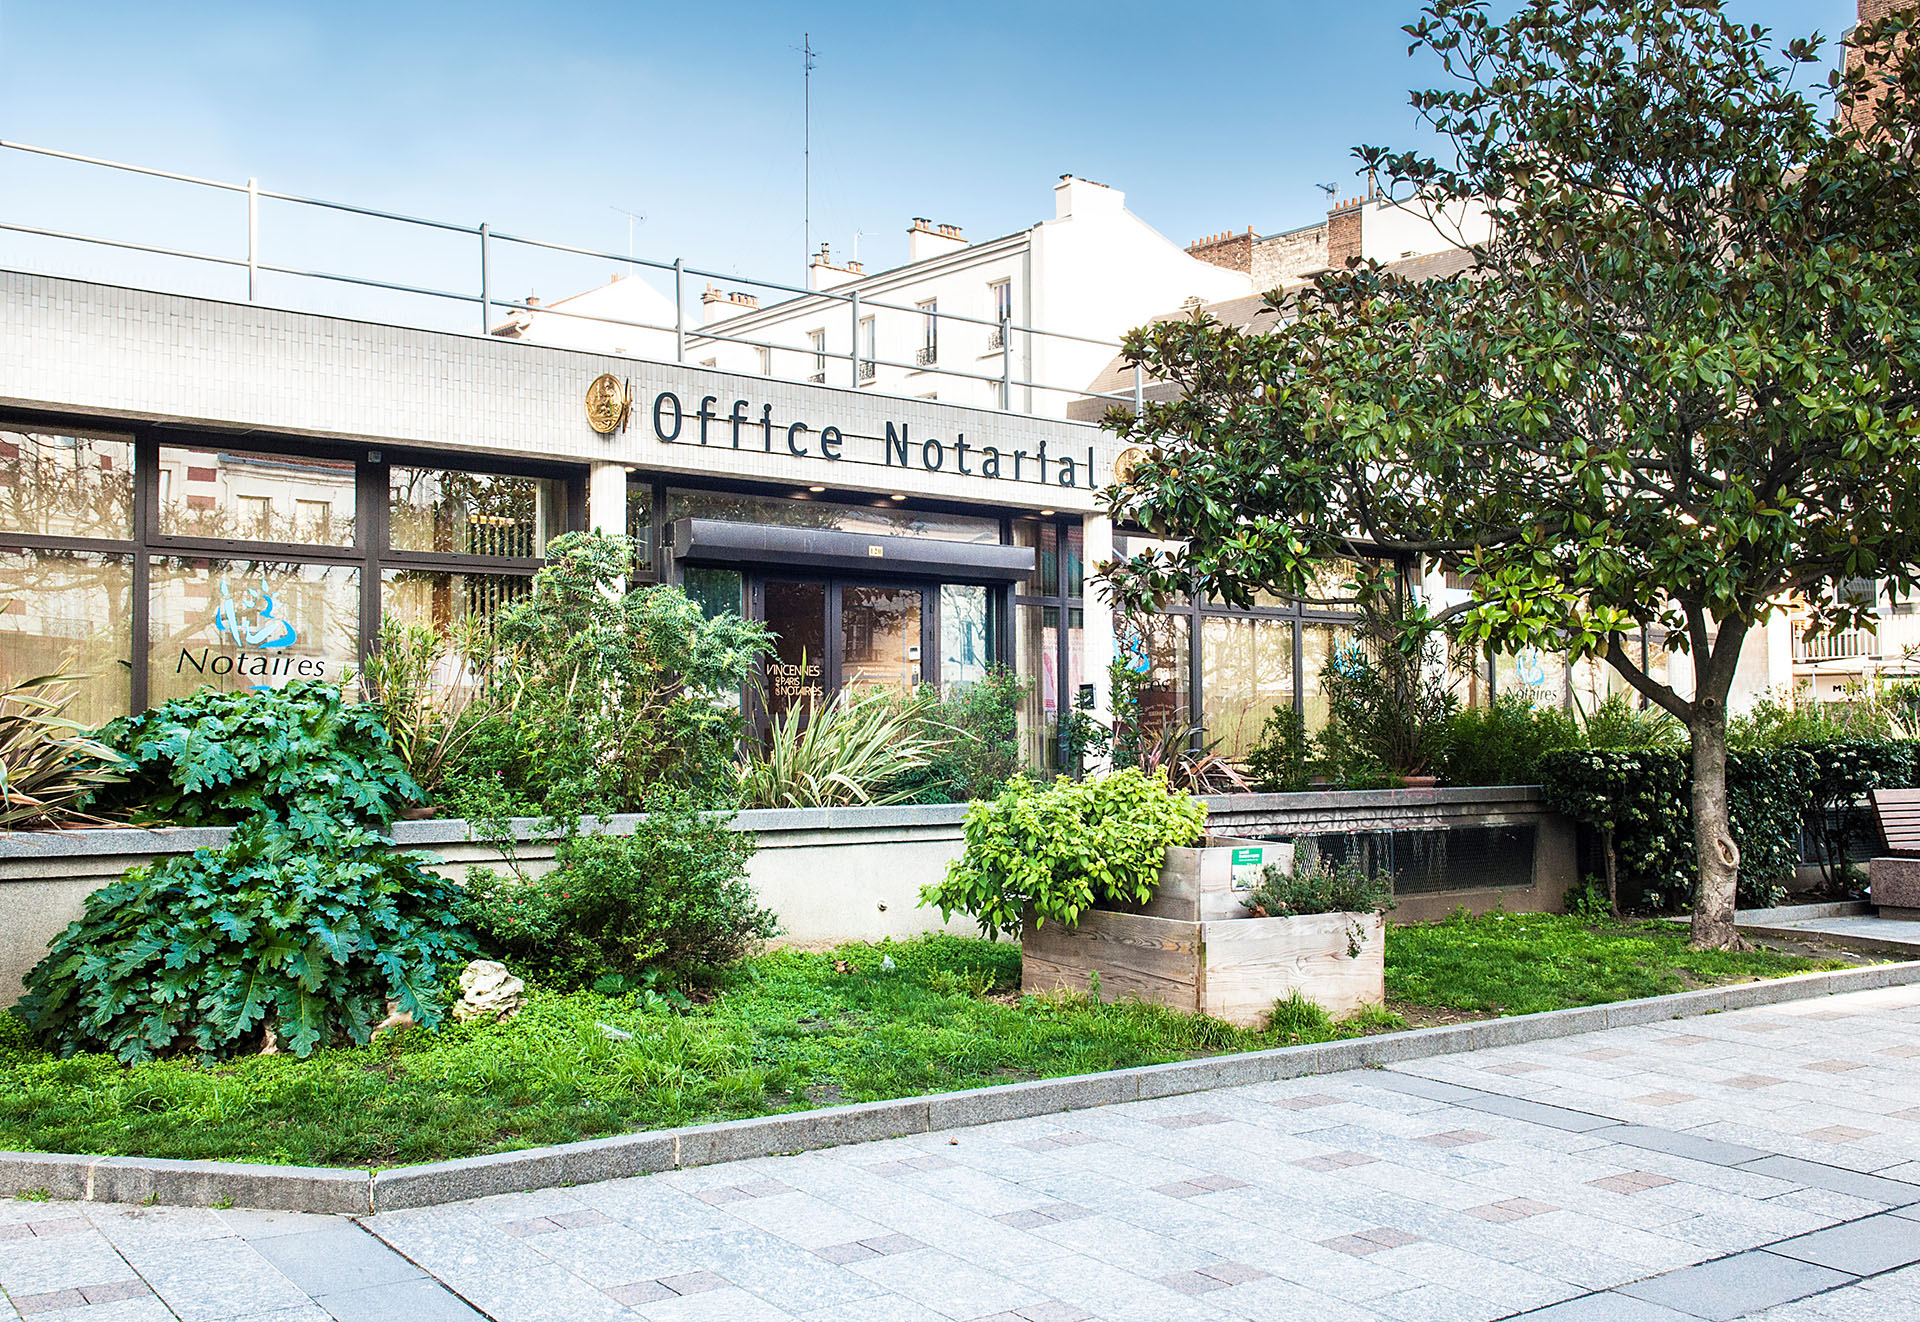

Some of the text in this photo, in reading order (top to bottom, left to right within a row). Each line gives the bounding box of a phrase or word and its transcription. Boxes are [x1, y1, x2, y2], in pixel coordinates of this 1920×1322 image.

[652, 391, 1098, 490] Office Notarial
[176, 648, 325, 677] Notaires
[766, 663, 820, 677] VINCENNES
[780, 677, 800, 686] PARIS
